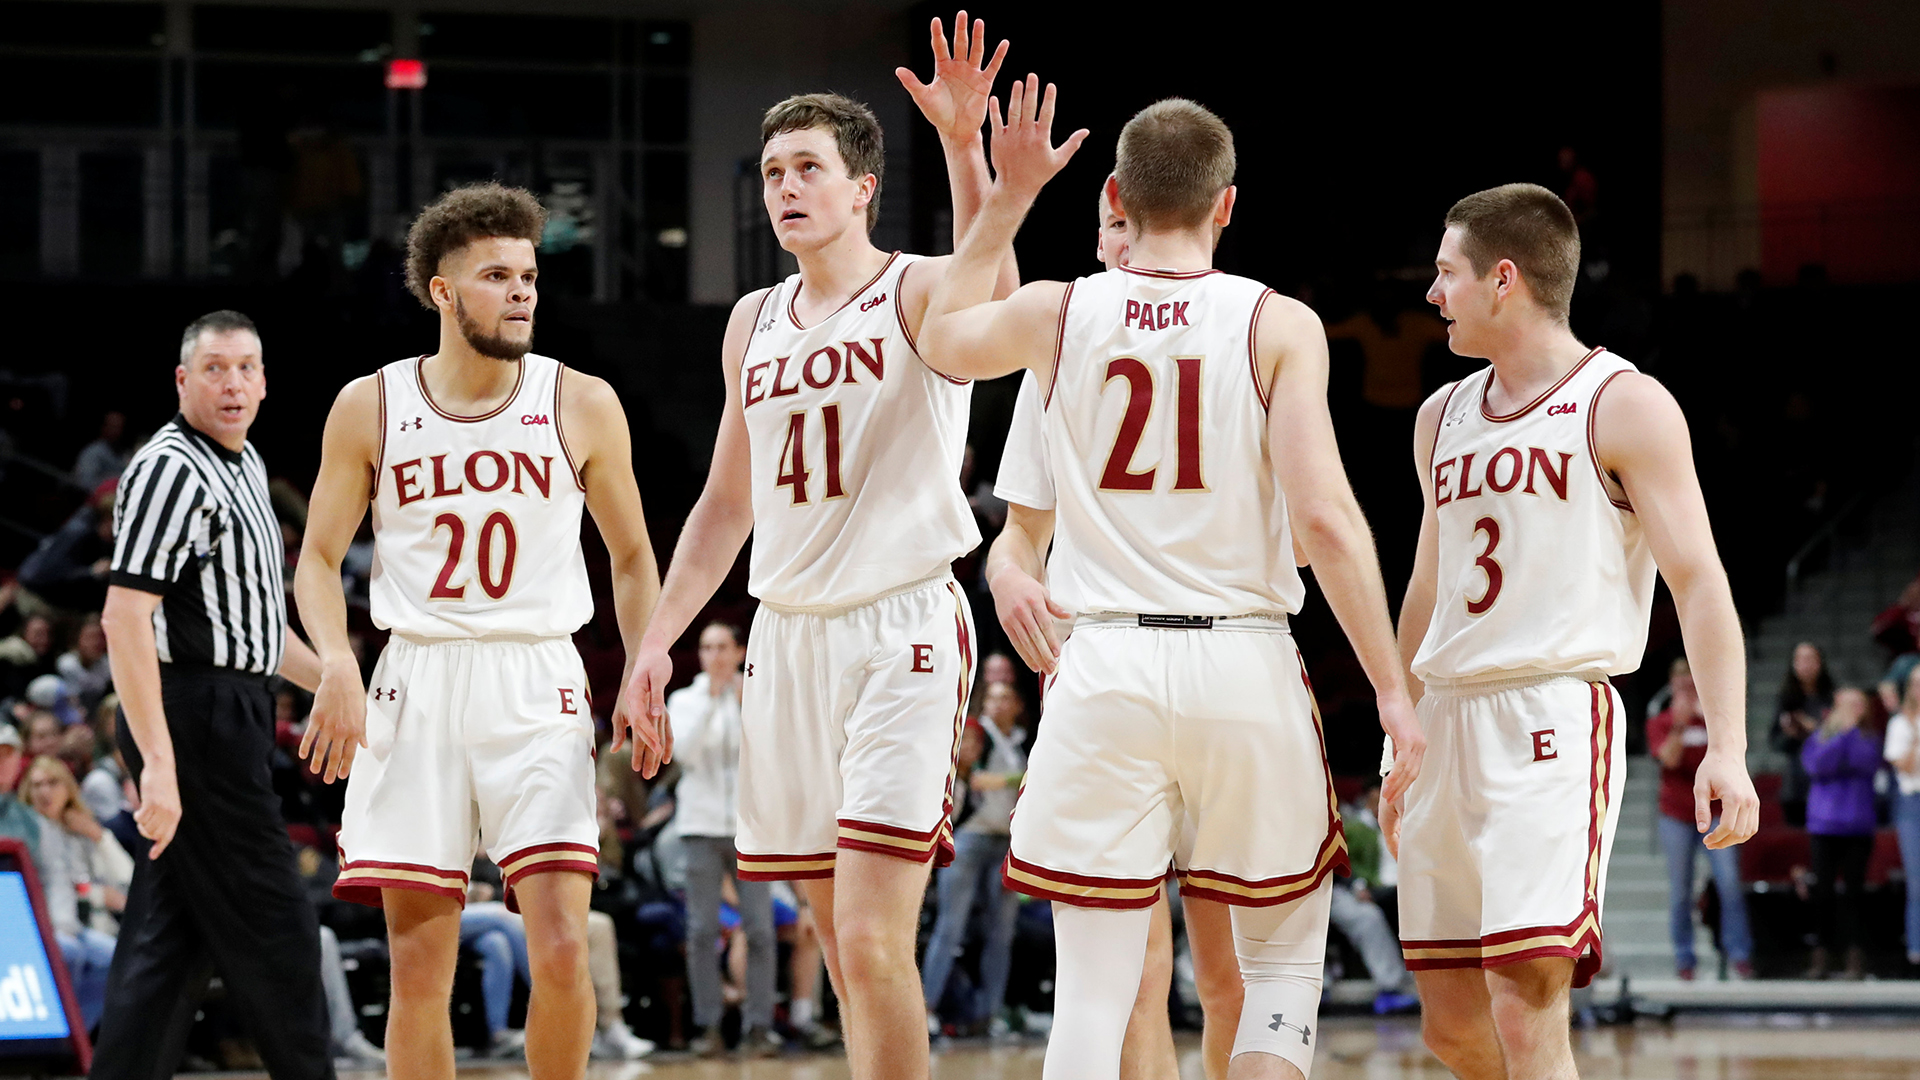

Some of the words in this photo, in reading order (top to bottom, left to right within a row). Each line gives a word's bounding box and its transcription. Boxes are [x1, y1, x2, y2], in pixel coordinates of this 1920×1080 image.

[860, 293, 887, 312] CAA
[1124, 299, 1190, 332] PACK
[743, 336, 888, 410] ELON
[520, 414, 550, 426] CAA
[1096, 354, 1213, 494] 21
[1547, 402, 1577, 417] CAA
[774, 401, 850, 508] 41
[1433, 446, 1577, 511] ELON
[389, 449, 557, 511] ELON
[426, 508, 520, 603] 20
[1462, 513, 1506, 618] 3
[909, 643, 935, 674] E
[557, 687, 578, 716] E
[1529, 728, 1559, 763] E
